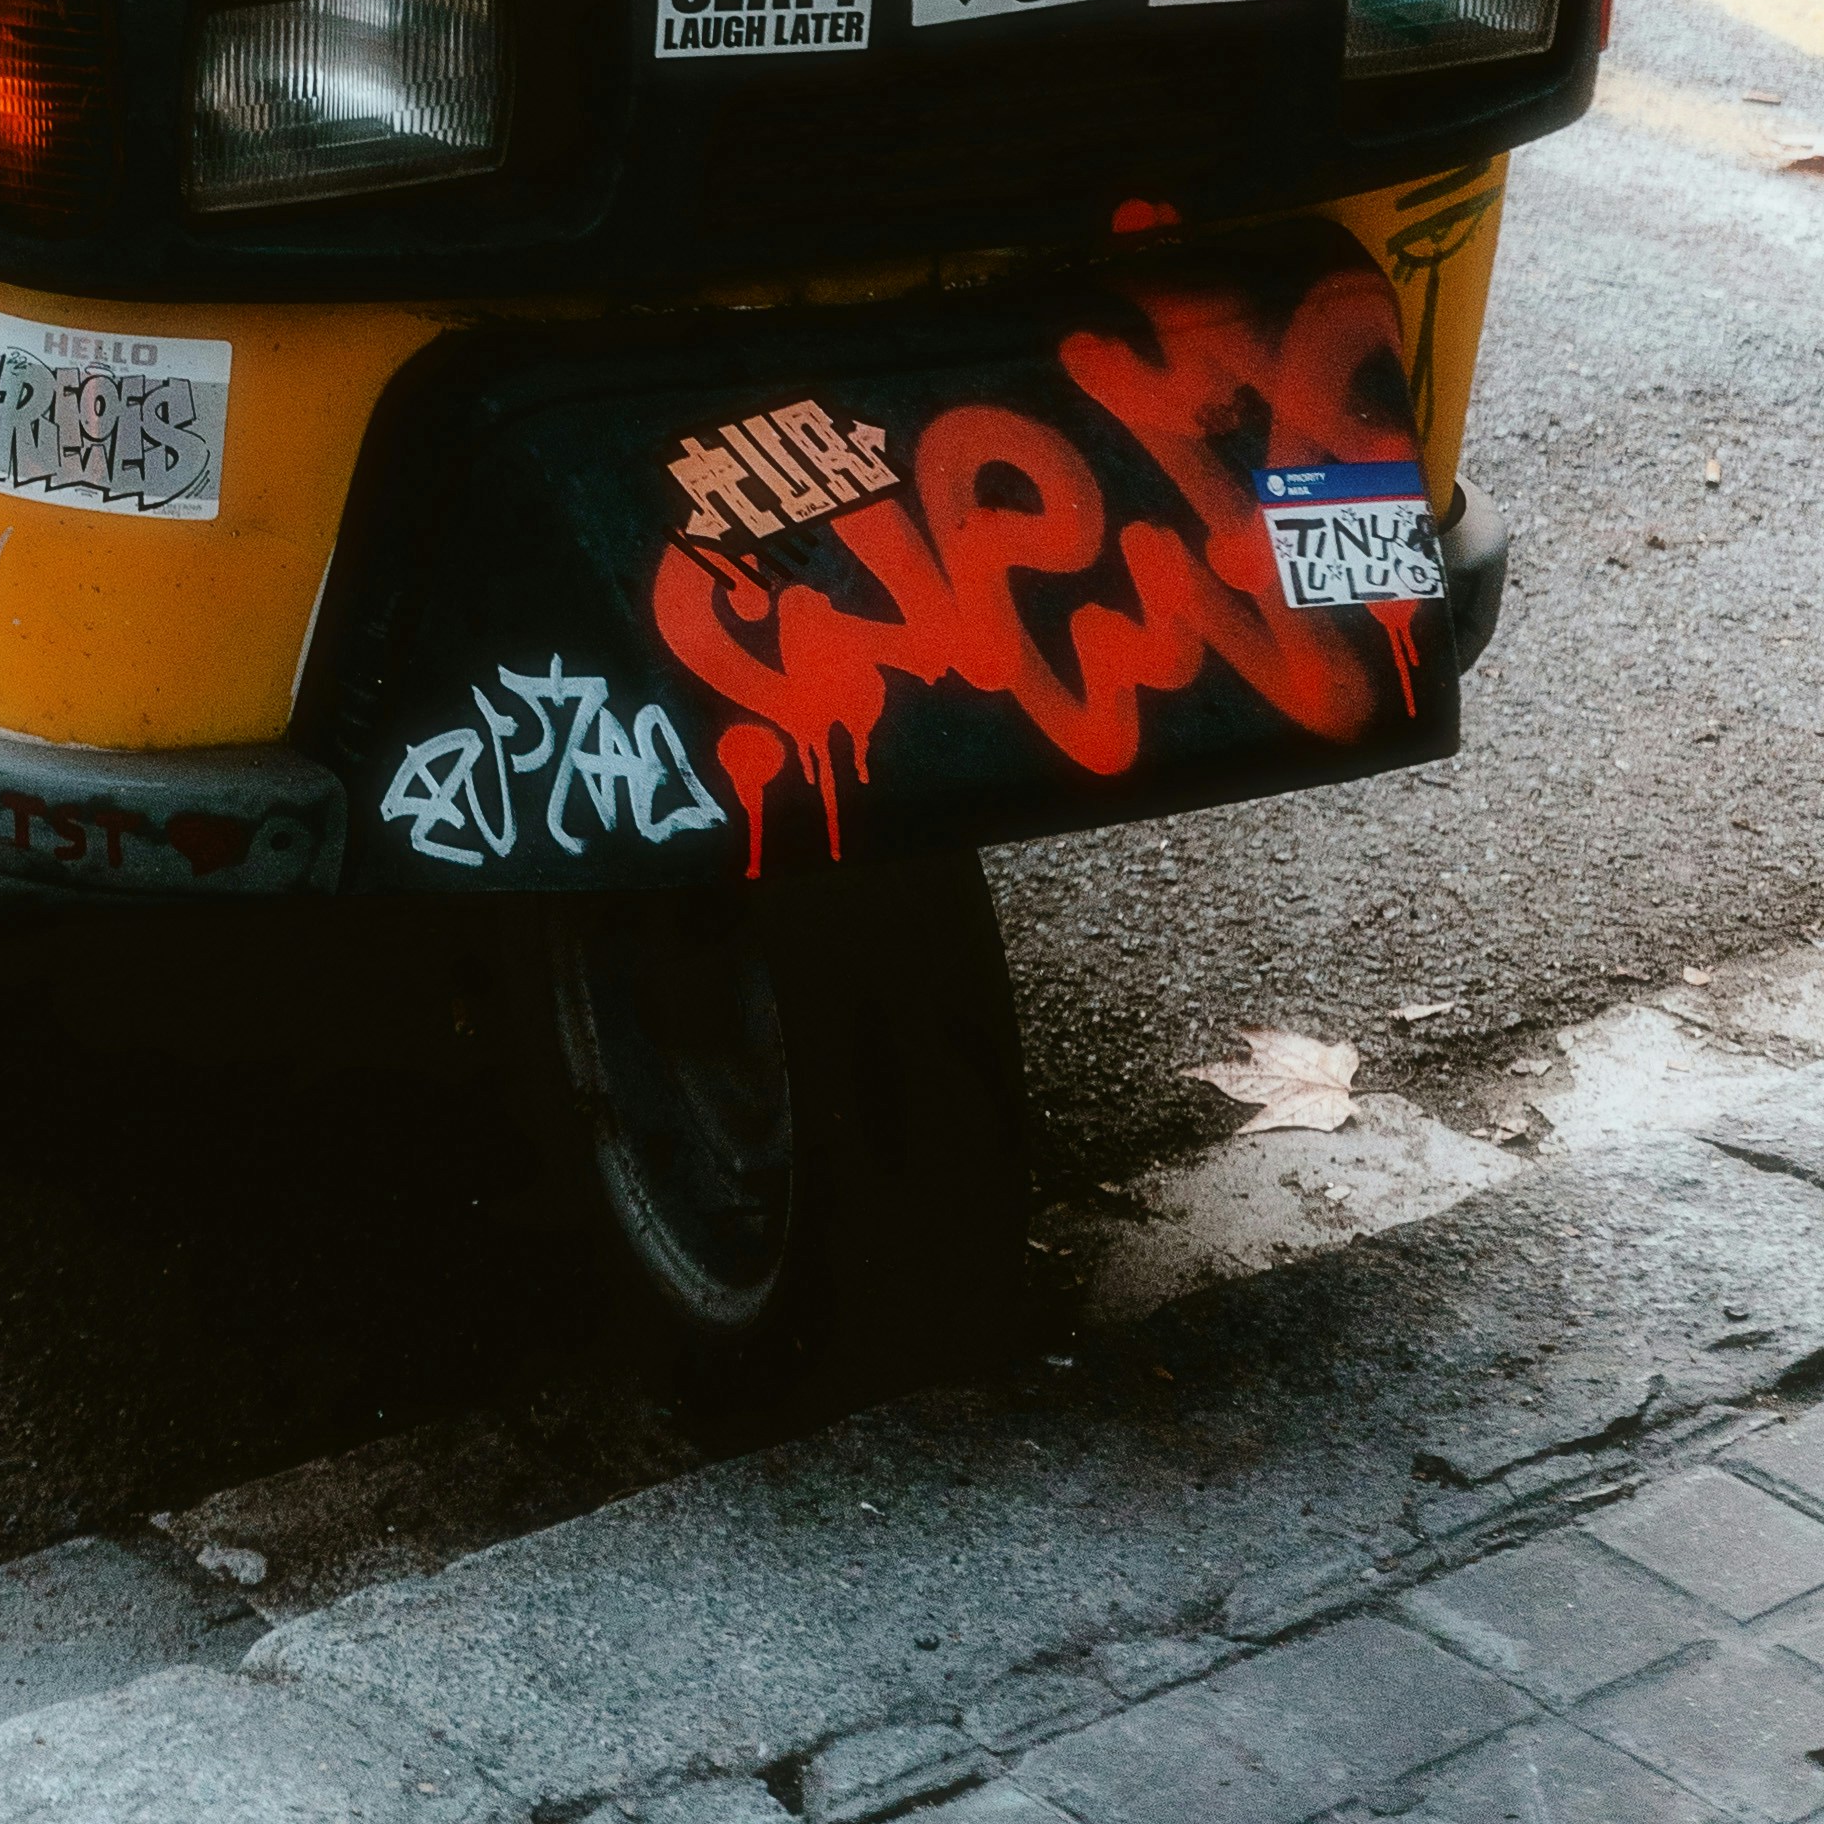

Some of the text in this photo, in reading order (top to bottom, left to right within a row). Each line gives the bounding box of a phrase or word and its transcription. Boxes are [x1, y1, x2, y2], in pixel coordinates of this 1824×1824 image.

[663, 11, 865, 50] LAUGH LATER
[42, 332, 160, 367] HELLO
